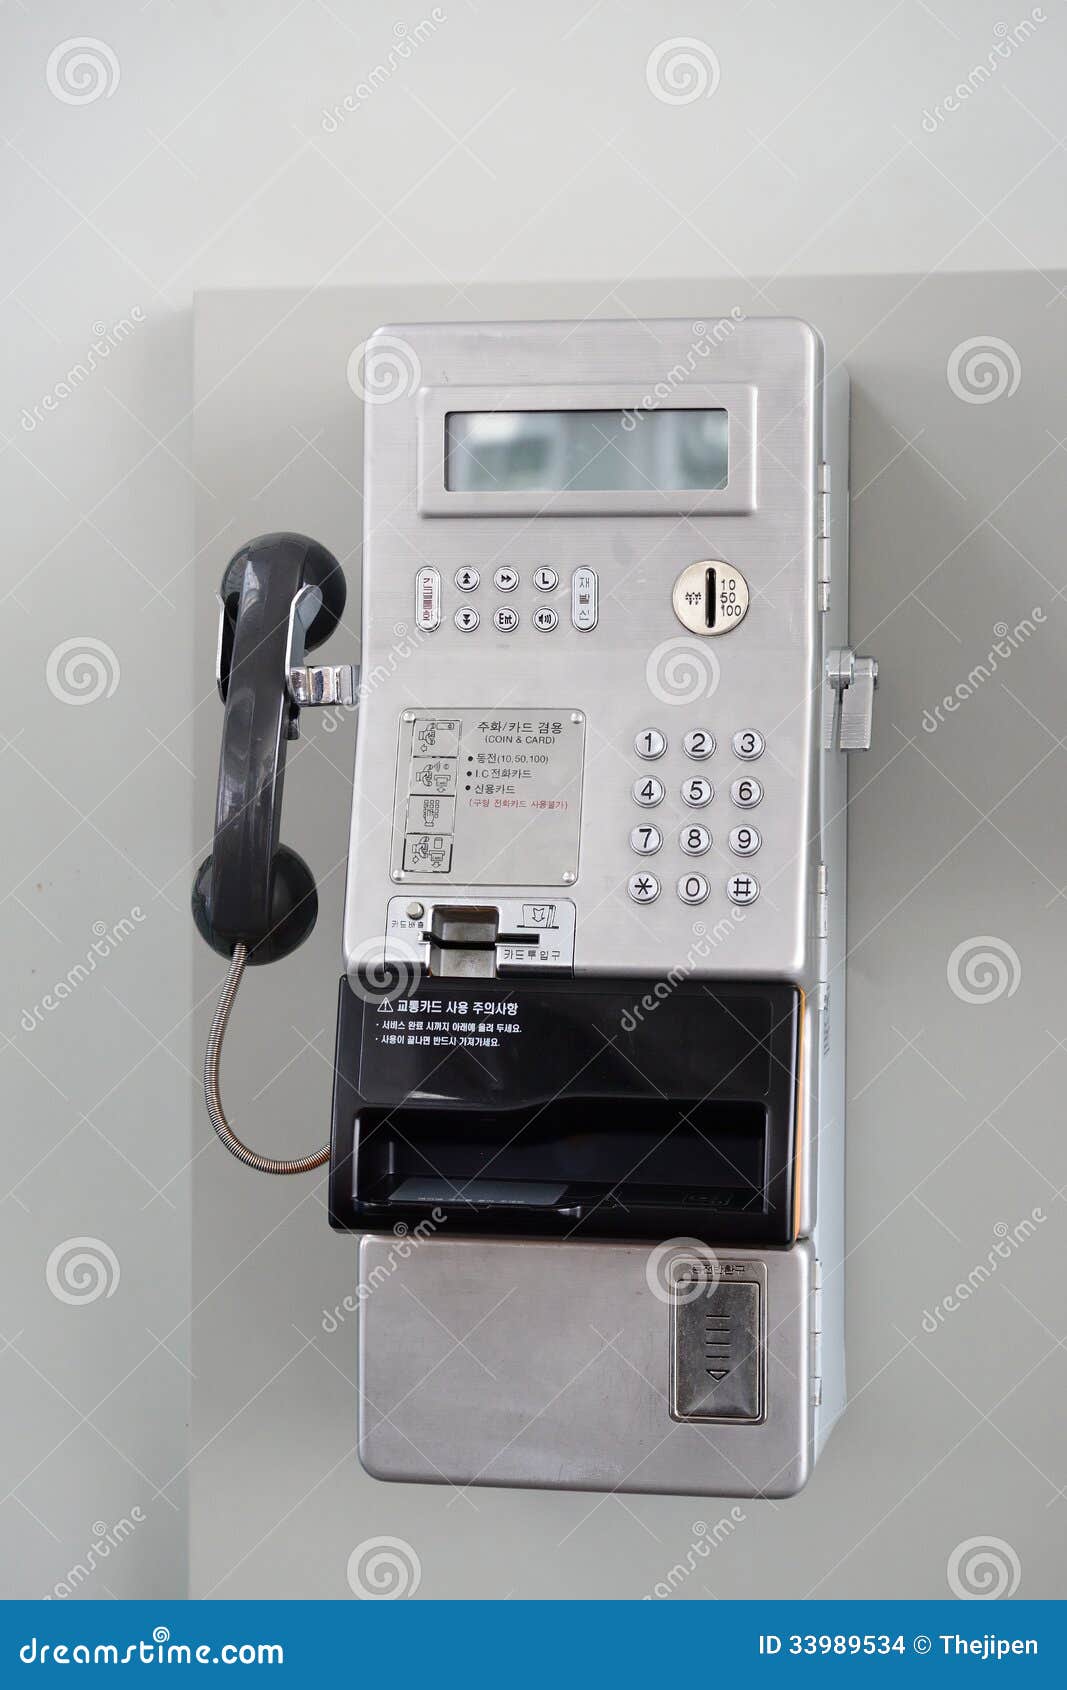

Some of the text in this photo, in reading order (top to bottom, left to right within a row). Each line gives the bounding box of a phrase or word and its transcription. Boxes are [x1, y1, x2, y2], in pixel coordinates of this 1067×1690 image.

[542, 572, 549, 584] L
[721, 579, 736, 591] 10
[579, 577, 590, 621] 재발신
[720, 592, 736, 604] 50
[721, 605, 742, 617] 100
[499, 612, 512, 625] Ent
[477, 721, 534, 733] 주화/카드
[485, 735, 555, 745] (COIN & CARD)
[645, 732, 652, 752] 1
[691, 733, 705, 752] 2
[741, 733, 755, 753] 3
[474, 784, 516, 794] 신용카드
[641, 780, 654, 800] 4
[689, 781, 703, 800] 5
[739, 781, 753, 800] 6
[494, 799, 527, 808] 전화카드
[639, 828, 652, 848] 7
[687, 829, 701, 848] 8
[738, 829, 751, 848] 9
[685, 877, 700, 896] 0
[504, 949, 561, 961] 카드투입구
[397, 1000, 518, 1016] 교통카드 사용 주의사항
[382, 1020, 406, 1030] 서비스
[408, 1021, 424, 1031] 완료
[426, 1021, 449, 1031] 시까지
[452, 1022, 476, 1032] 아래에
[496, 1023, 522, 1033] 두세요.
[381, 1035, 405, 1045] 사용이
[433, 1036, 457, 1046] 반드시
